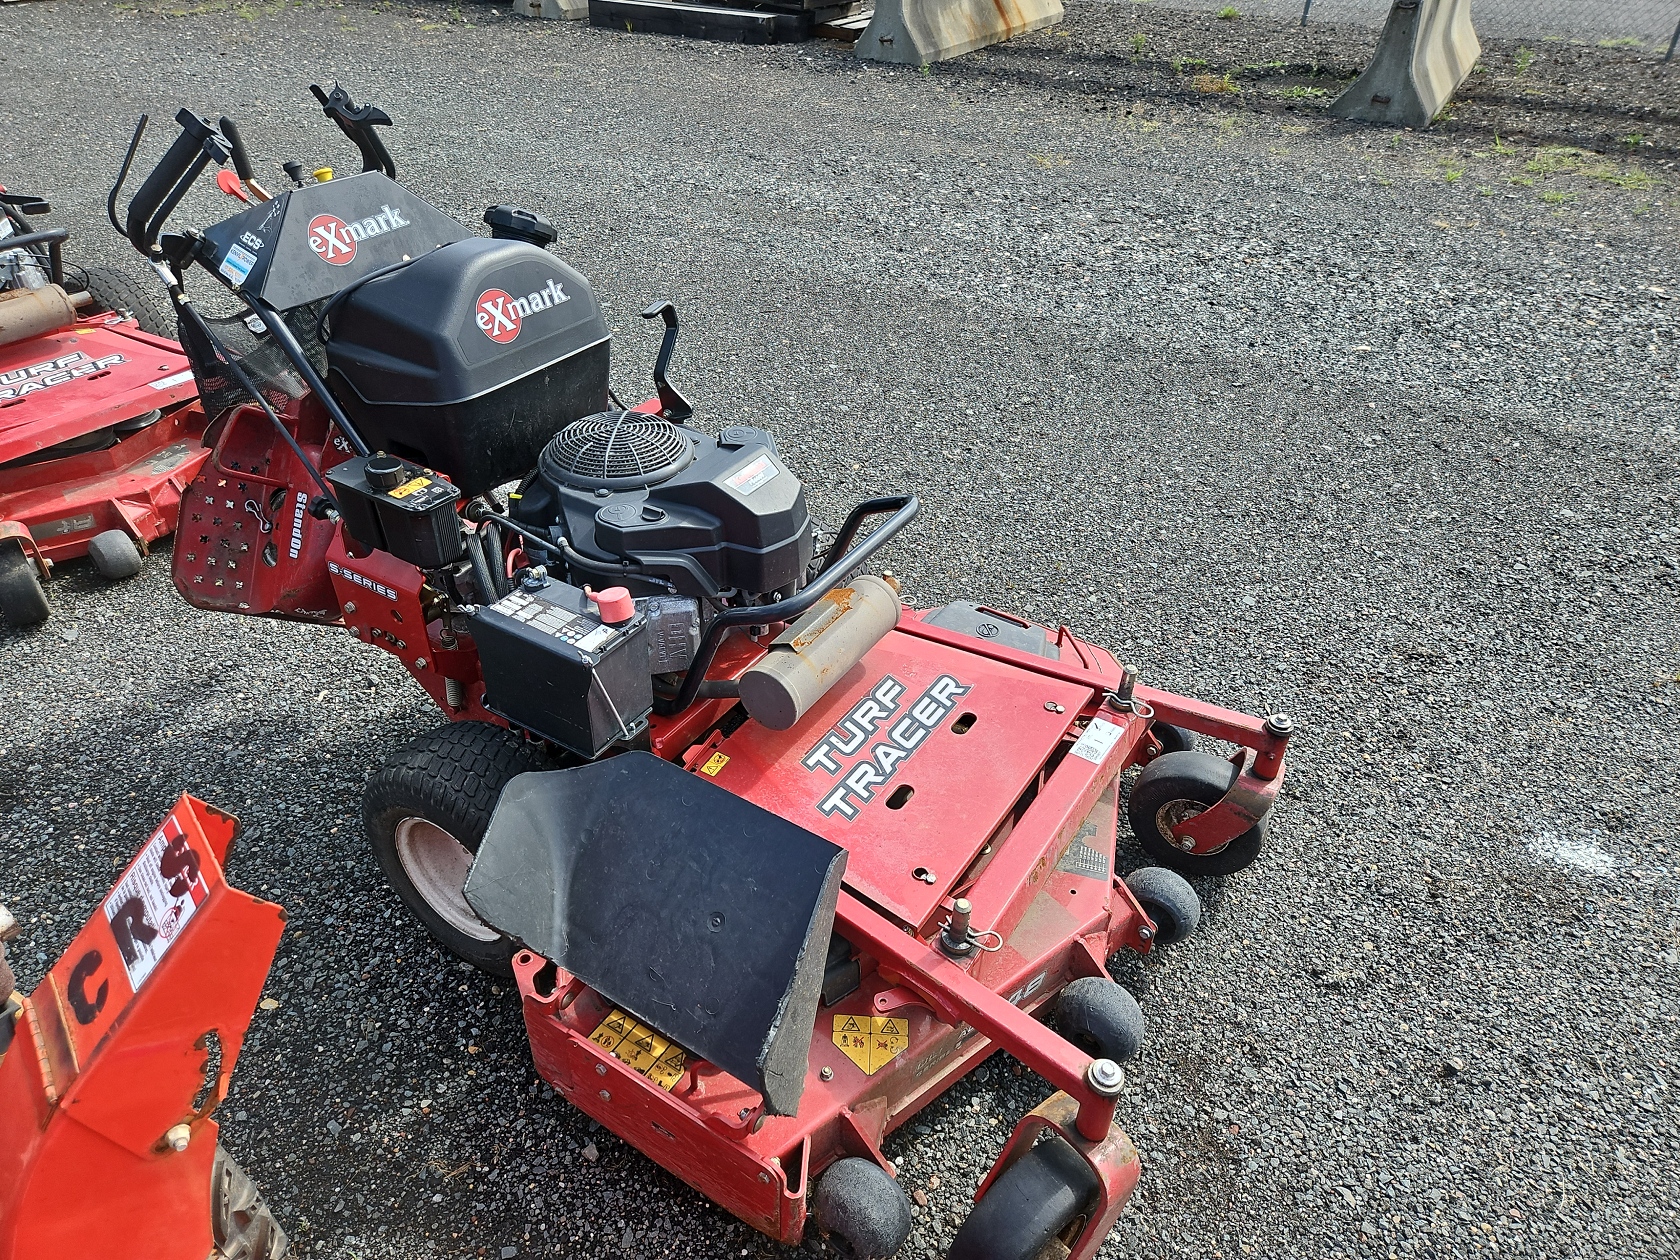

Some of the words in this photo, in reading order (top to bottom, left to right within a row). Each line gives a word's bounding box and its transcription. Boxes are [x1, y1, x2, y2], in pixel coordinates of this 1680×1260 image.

[243, 231, 263, 250] ECS
[0, 351, 82, 386] URF
[0, 354, 130, 400] RACER
[289, 492, 308, 559] StandOn
[328, 561, 398, 601] S-SERIES
[802, 675, 907, 776] TURF
[816, 675, 974, 821] TRACER
